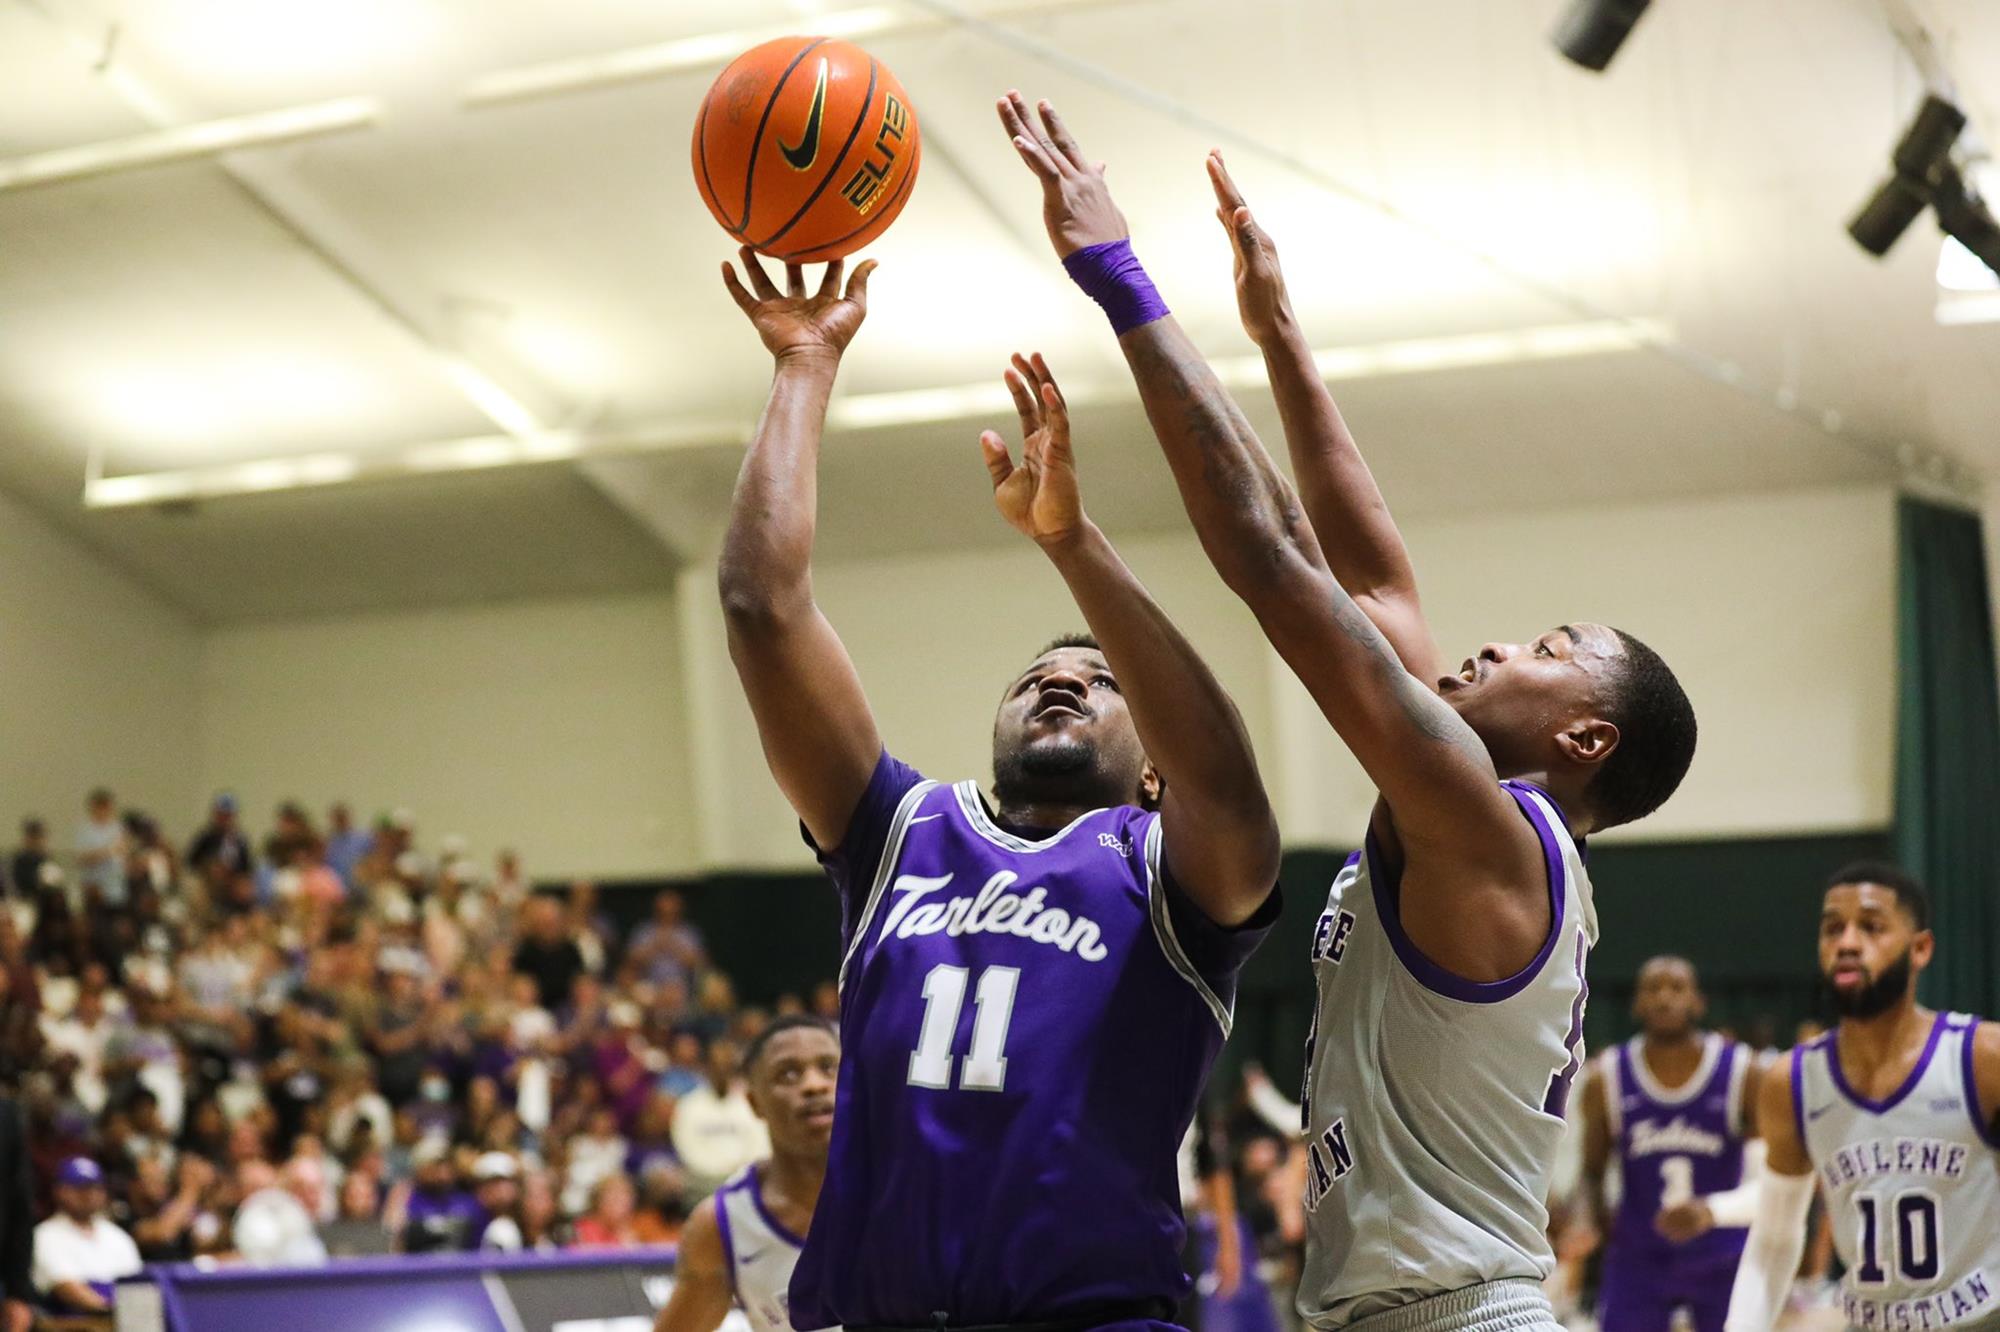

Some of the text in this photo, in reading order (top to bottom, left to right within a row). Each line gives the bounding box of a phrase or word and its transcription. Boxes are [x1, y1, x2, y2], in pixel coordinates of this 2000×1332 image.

[839, 92, 907, 209] ELITE
[876, 869, 1109, 962] Tarleton
[906, 962, 1022, 1093] 11
[1855, 1190, 1941, 1286] 10
